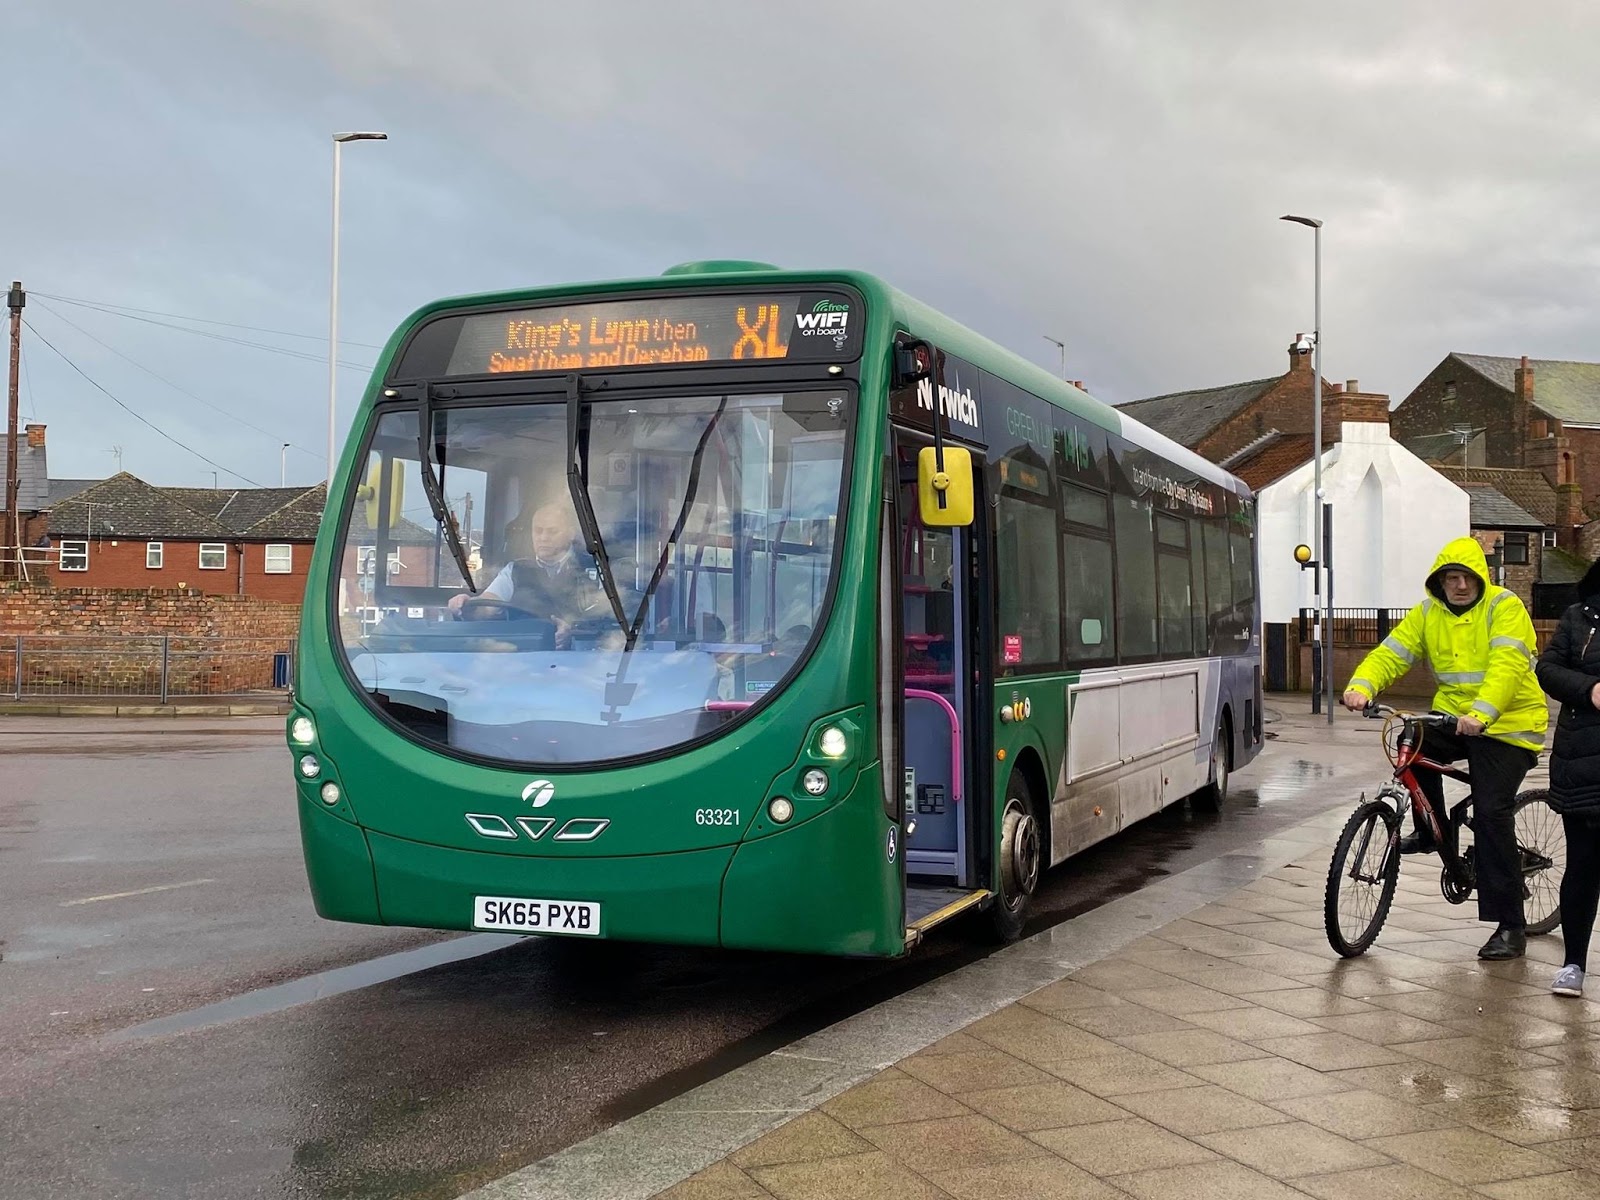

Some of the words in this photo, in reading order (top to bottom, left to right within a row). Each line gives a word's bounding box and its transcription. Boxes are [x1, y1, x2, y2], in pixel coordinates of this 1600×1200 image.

[829, 303, 849, 311] free
[796, 312, 848, 328] WIFI
[507, 318, 581, 349] King's
[588, 317, 650, 345] Lynn
[653, 319, 697, 341] then
[732, 304, 786, 359] XL
[816, 327, 846, 336] board
[587, 344, 621, 368] and
[695, 808, 741, 826] 63321
[484, 900, 542, 927] SK65
[547, 903, 591, 930] PXB
